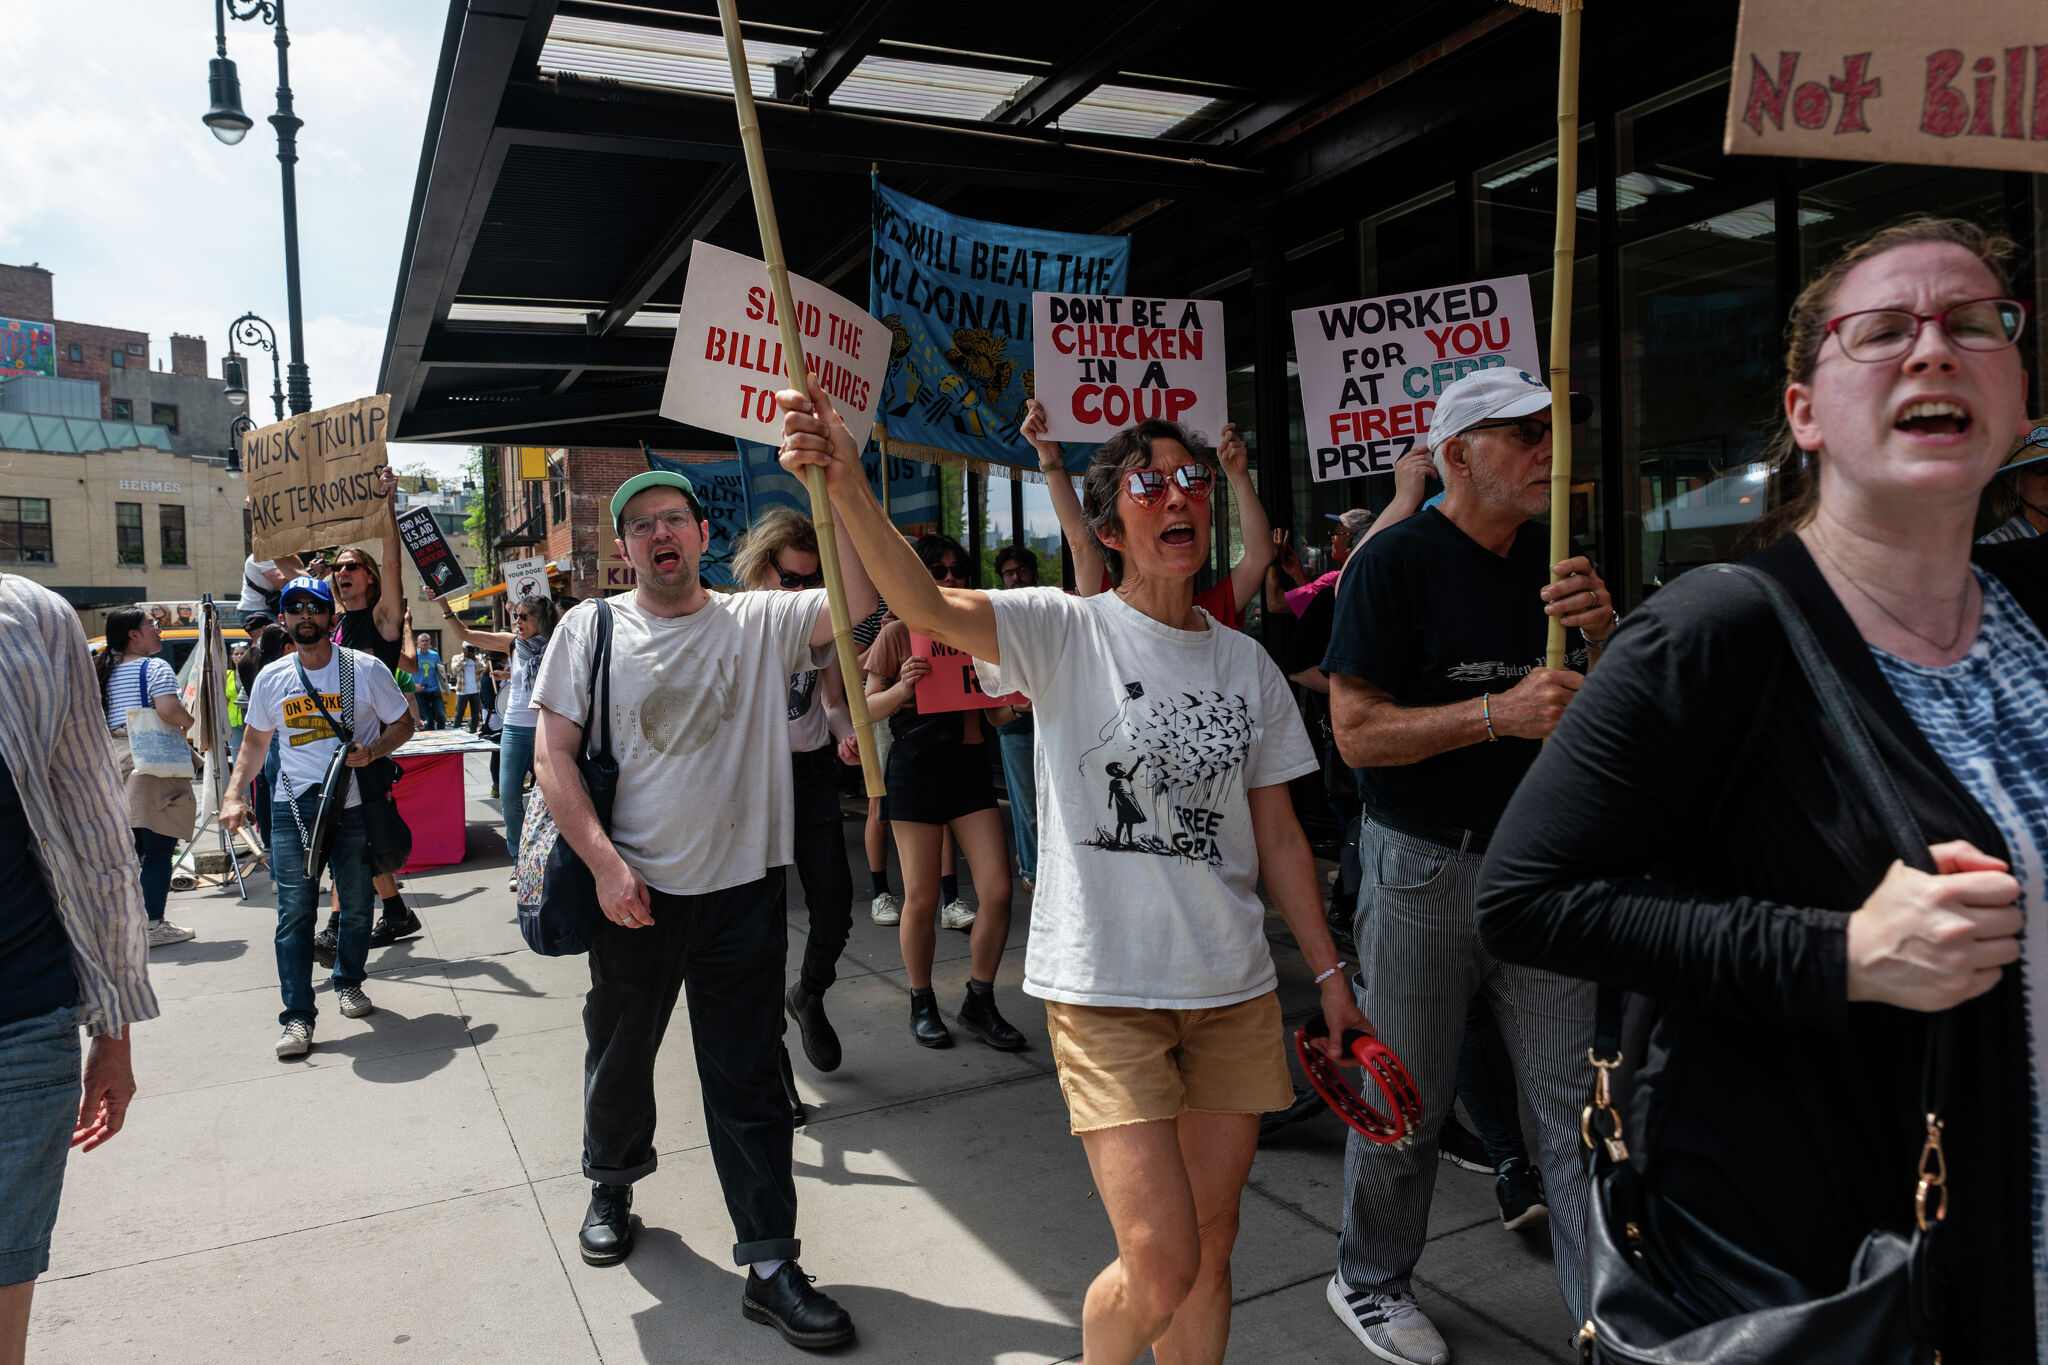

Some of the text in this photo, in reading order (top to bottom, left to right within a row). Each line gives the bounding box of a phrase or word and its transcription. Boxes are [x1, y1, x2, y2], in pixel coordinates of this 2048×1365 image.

[1742, 51, 1882, 137] Not
[904, 219, 961, 275] WILL
[970, 240, 1048, 290] BEAT
[1056, 254, 1114, 295] THE
[872, 244, 1033, 342] BILLIONAI
[1050, 296, 1203, 330] DON'T BE A
[1318, 284, 1498, 341] WORKED
[828, 312, 863, 360] THE
[1052, 324, 1203, 361] CHICKEN
[1342, 316, 1511, 374] FOR YOU
[705, 326, 870, 412] BILLINAIRES
[1078, 358, 1169, 389] IN A
[740, 384, 777, 424] TO
[1072, 384, 1198, 427] COUP
[1339, 373, 1385, 410] AT
[247, 425, 300, 473] MUSK
[311, 407, 386, 456] TRUMP
[1329, 400, 1437, 445] FIRED
[251, 465, 389, 535] ARE TERRORISTS
[400, 512, 429, 533] END ALL
[410, 533, 439, 551] TO ISRAEL
[419, 523, 434, 537] AID
[508, 567, 543, 579] YOUR DOGE!
[516, 561, 533, 570] CURB
[285, 696, 343, 716] ON SRIKE
[1175, 806, 1225, 837] FREE
